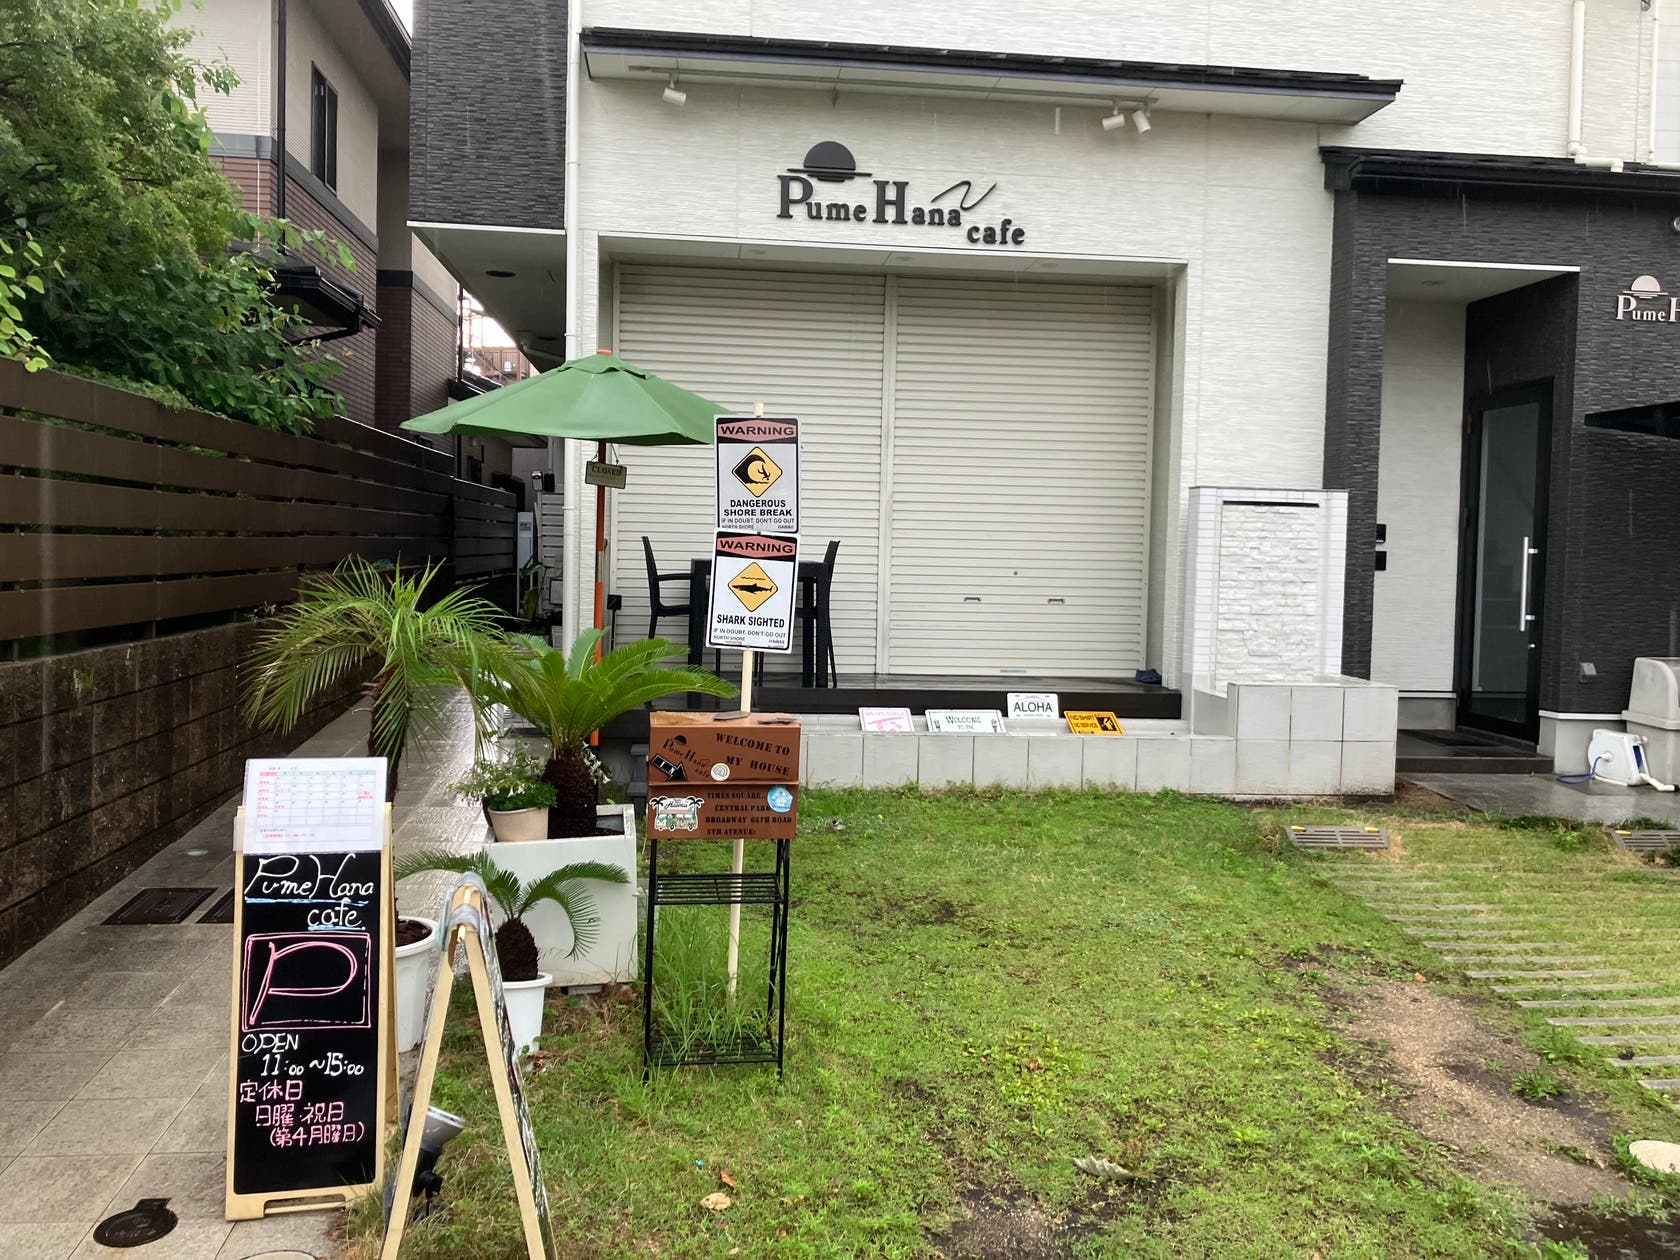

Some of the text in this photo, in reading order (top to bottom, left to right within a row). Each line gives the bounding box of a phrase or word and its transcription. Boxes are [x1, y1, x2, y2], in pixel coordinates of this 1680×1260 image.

[967, 219, 1025, 245] cafe
[720, 426, 794, 436] WARNING
[591, 465, 622, 476] CLOSED
[730, 499, 786, 508] DANGEROUS
[720, 540, 793, 553] WARNING
[716, 614, 785, 628] SHARK SIGHTED
[1013, 702, 1053, 713] ALOHA
[716, 732, 790, 756] WELCOME TO
[726, 755, 790, 776] MY HOUSE
[307, 897, 362, 927] cafe
[249, 941, 358, 1026] P
[241, 1033, 299, 1055] OPEN
[240, 1079, 303, 1103] 定休日
